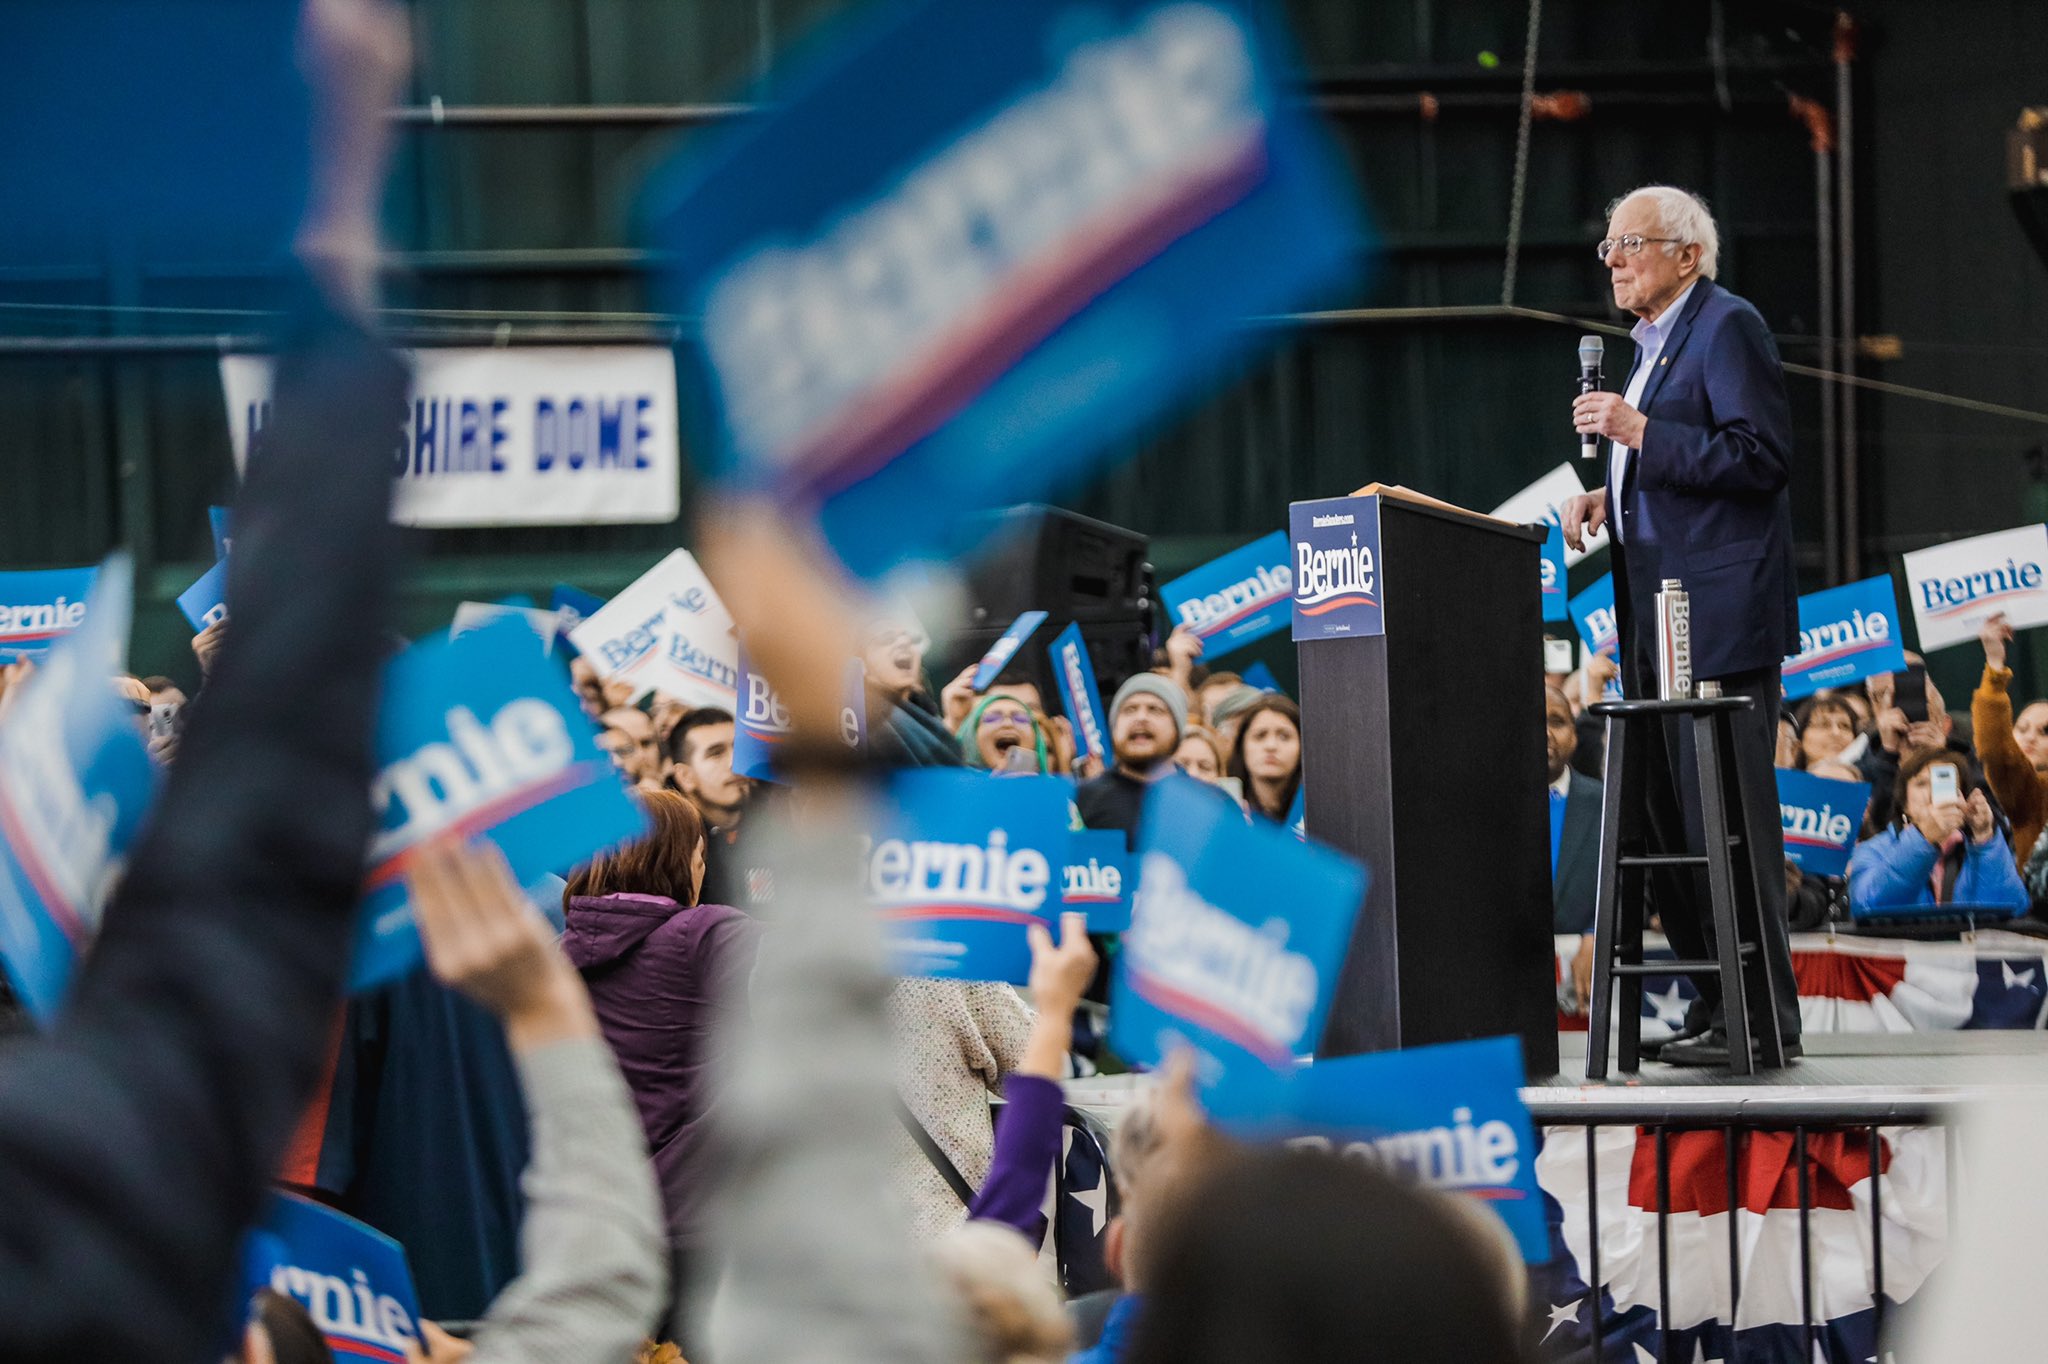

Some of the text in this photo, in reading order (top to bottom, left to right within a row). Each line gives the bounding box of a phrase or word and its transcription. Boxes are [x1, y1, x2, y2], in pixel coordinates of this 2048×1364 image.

[535, 396, 652, 470] DOME
[1176, 564, 1293, 625] Bernie
[1297, 530, 1375, 596] Bernie
[1919, 557, 2042, 610] Bernie
[1671, 599, 1692, 693] Bernie
[862, 828, 1050, 911] ernie
